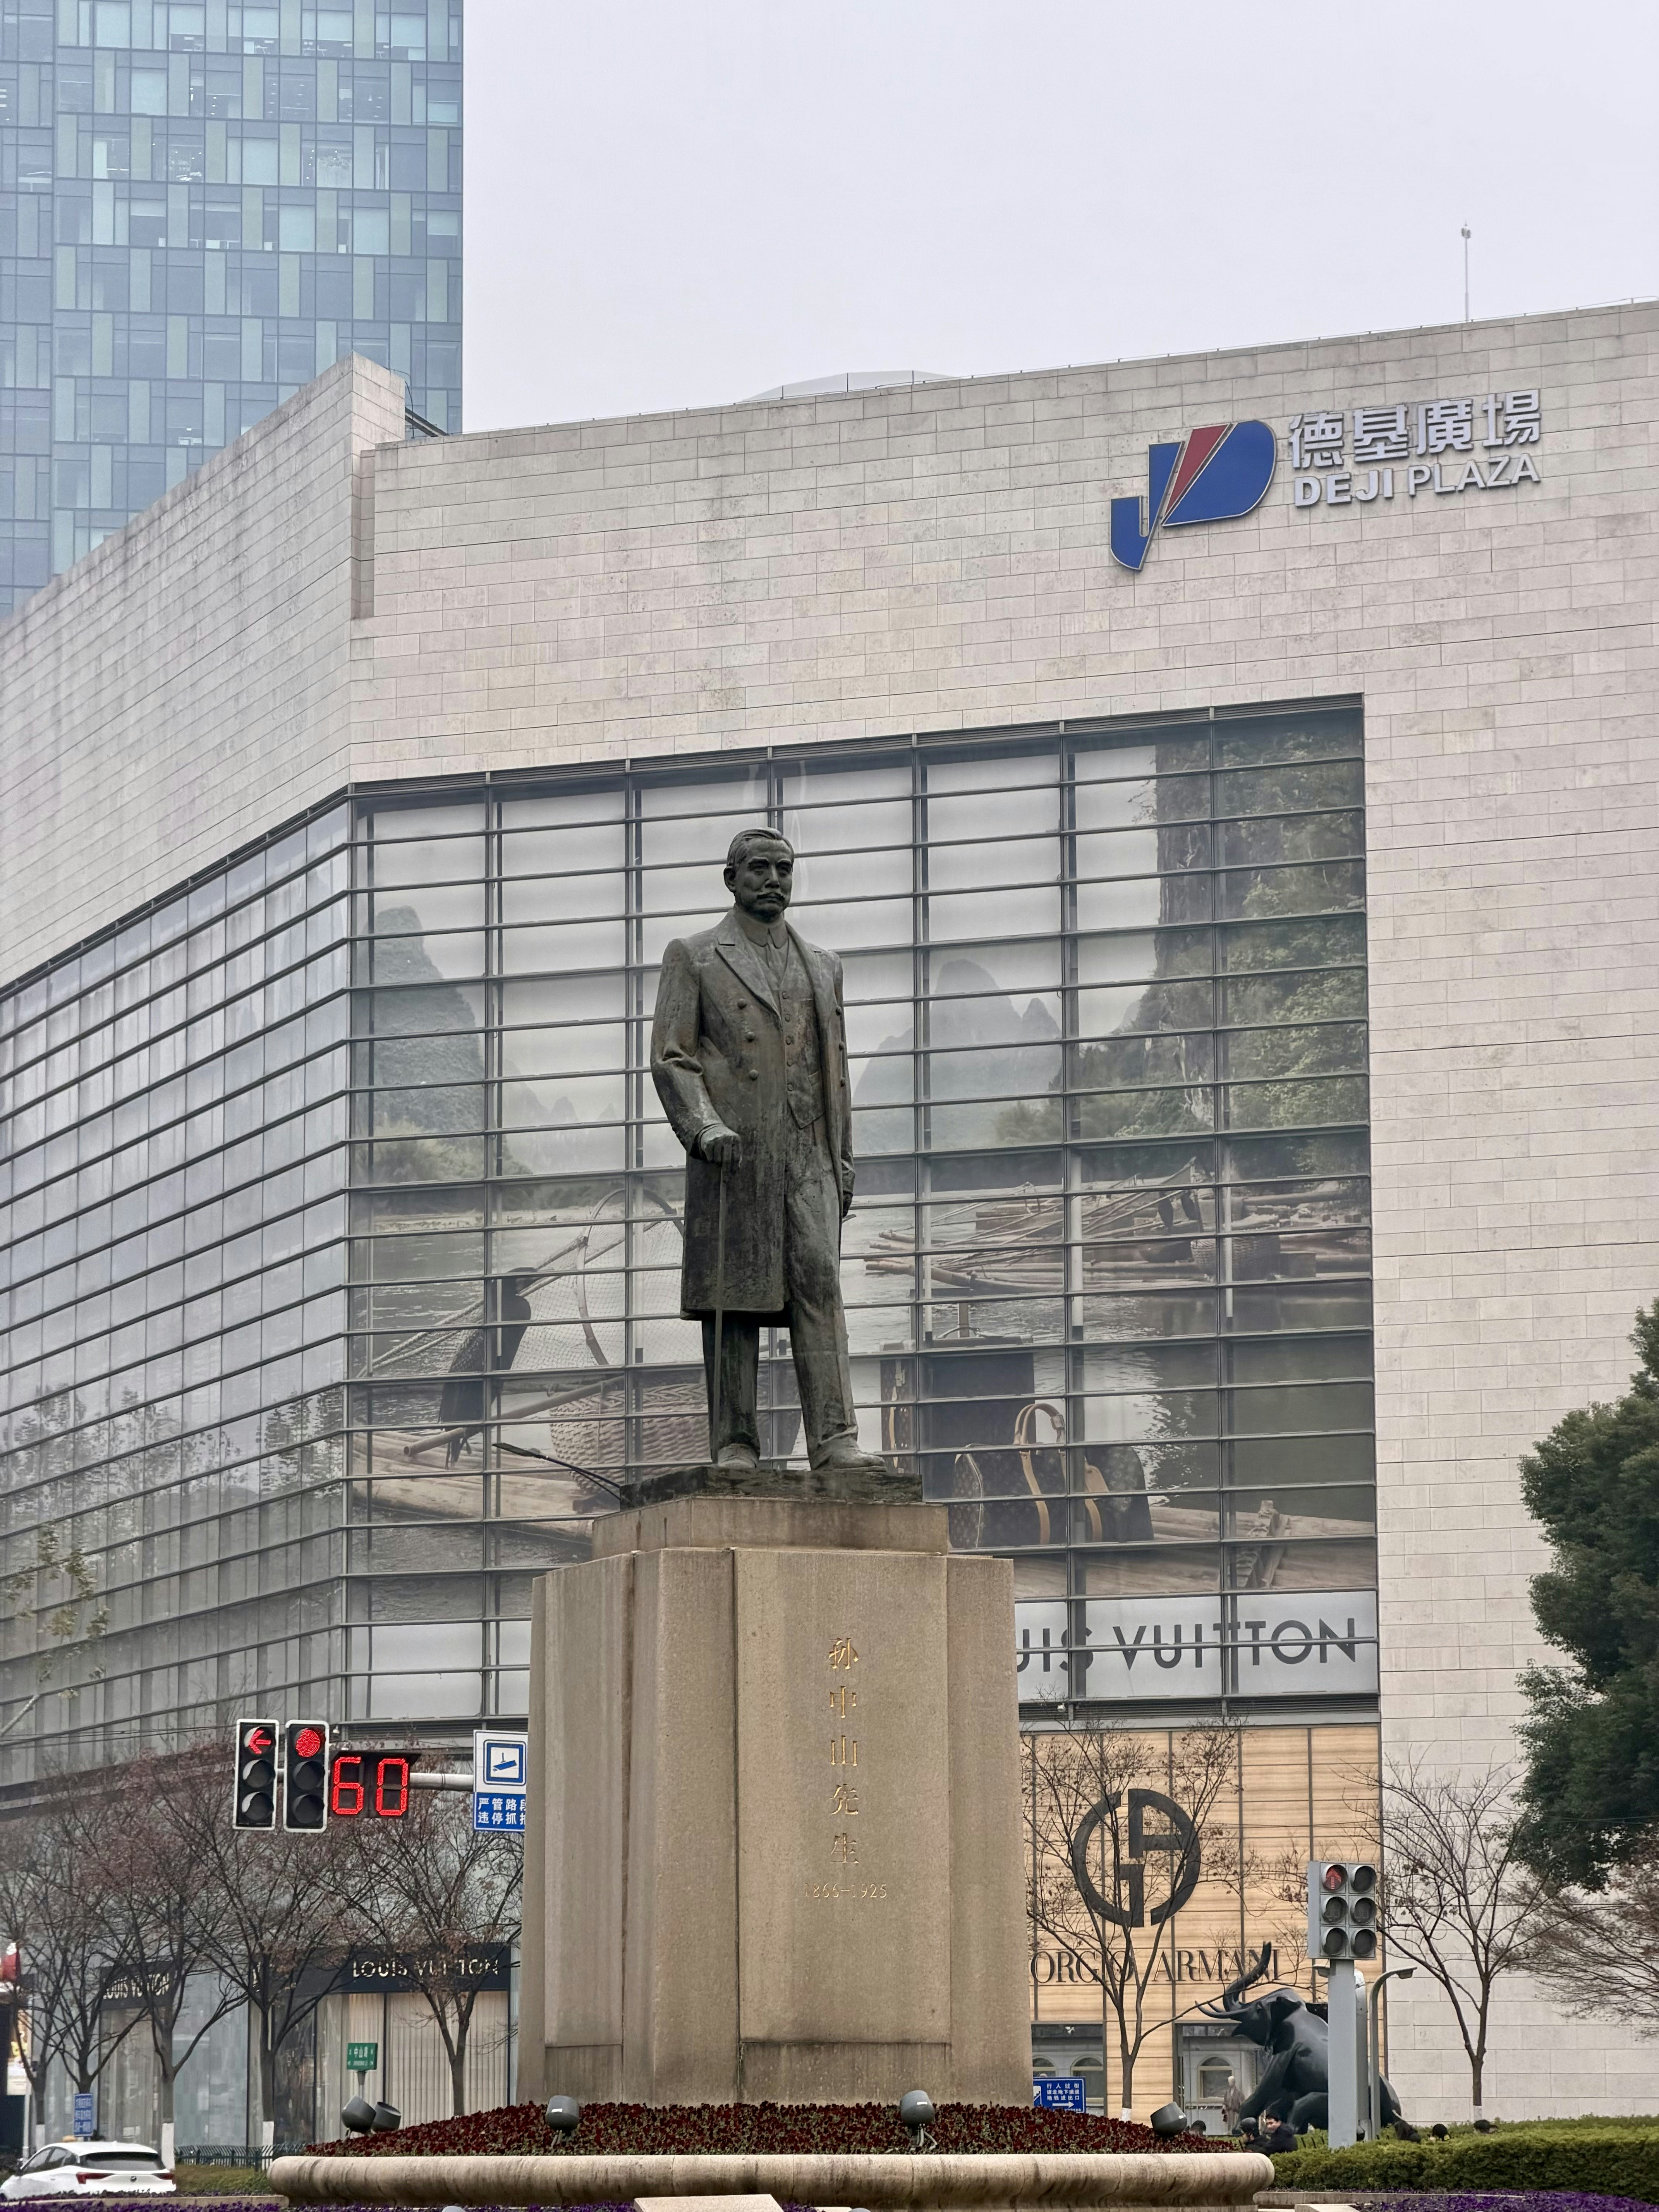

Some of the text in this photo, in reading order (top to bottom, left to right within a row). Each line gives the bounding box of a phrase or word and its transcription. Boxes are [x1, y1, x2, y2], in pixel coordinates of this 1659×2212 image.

[1288, 389, 1541, 470] 德基廣場
[1294, 453, 1541, 507] DEJI PLAZA
[1113, 1618, 1356, 1671] VUITTON
[828, 1637, 859, 1864] 孙中山先生
[332, 1756, 409, 1816] 60
[414, 1959, 498, 1976] VUITON
[1151, 1949, 1280, 1982] ARMANI
